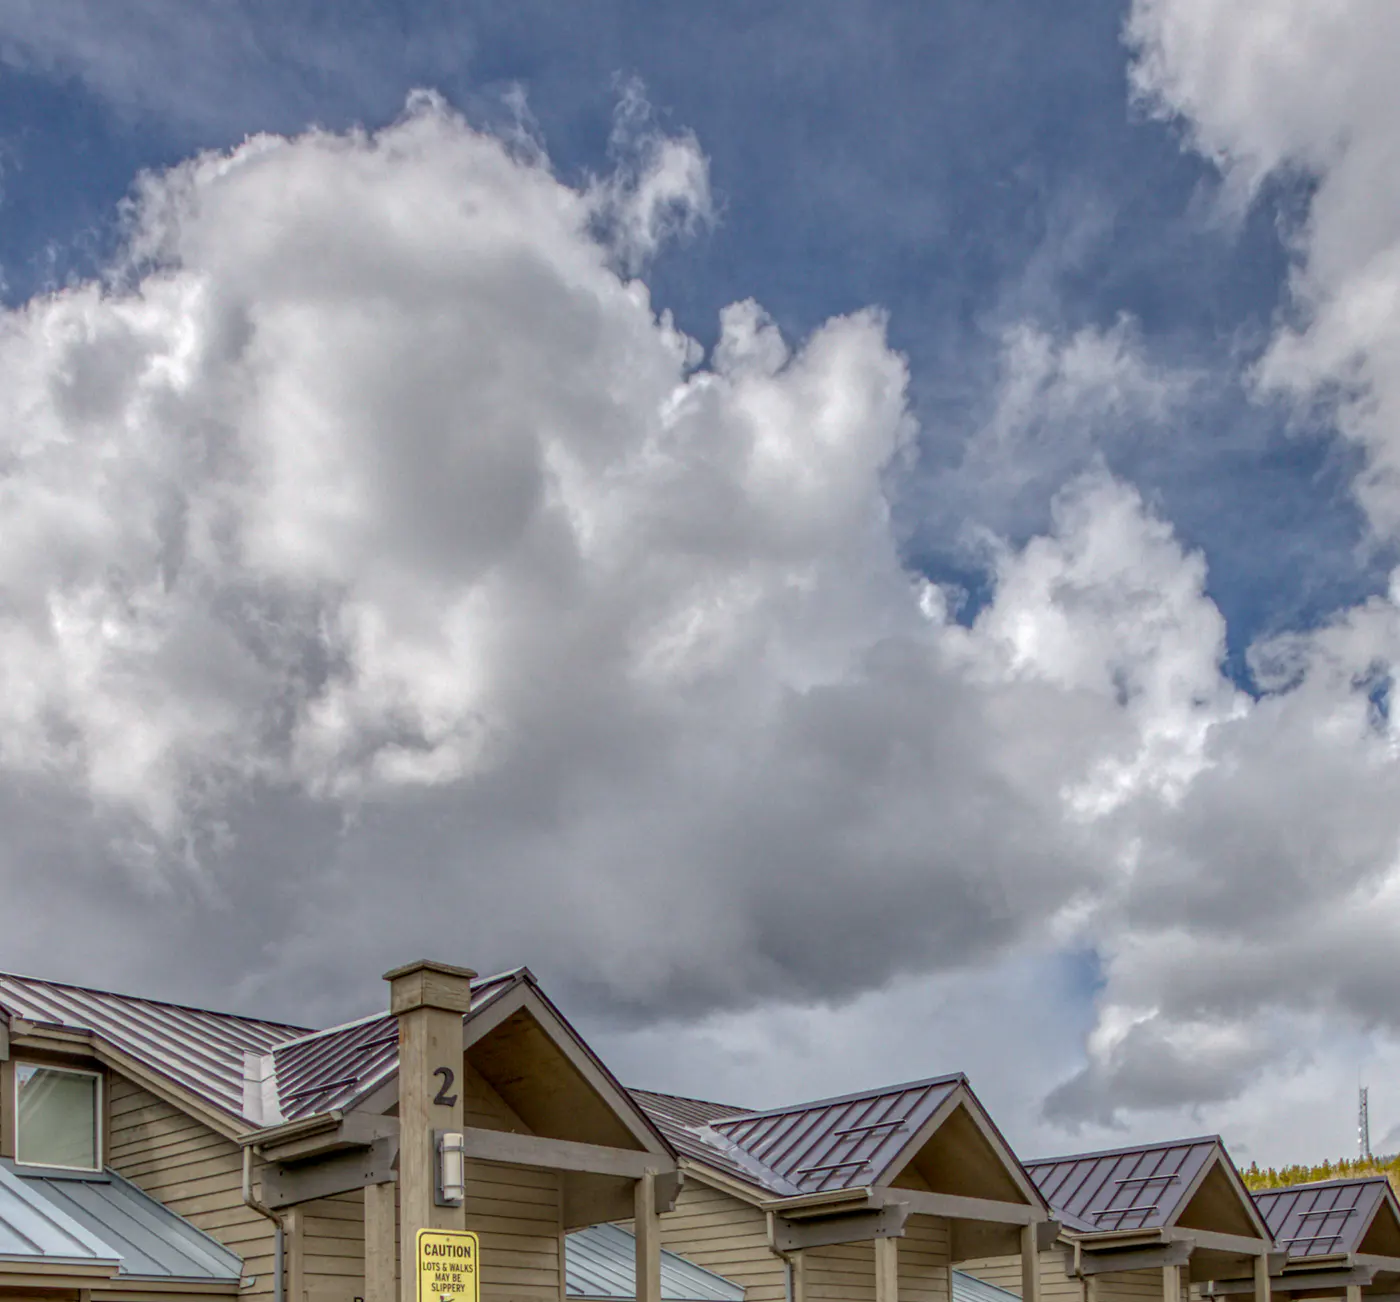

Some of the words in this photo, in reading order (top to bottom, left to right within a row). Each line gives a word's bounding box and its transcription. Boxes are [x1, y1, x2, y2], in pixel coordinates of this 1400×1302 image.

[433, 1066, 458, 1107] 2
[424, 1243, 471, 1258] CAUTION
[423, 1262, 440, 1271] LOTS
[442, 1263, 447, 1272] &
[449, 1263, 473, 1273] WALKS
[435, 1273, 450, 1282] MAY
[452, 1273, 461, 1282] BE
[431, 1283, 465, 1292] SLIPPERY
